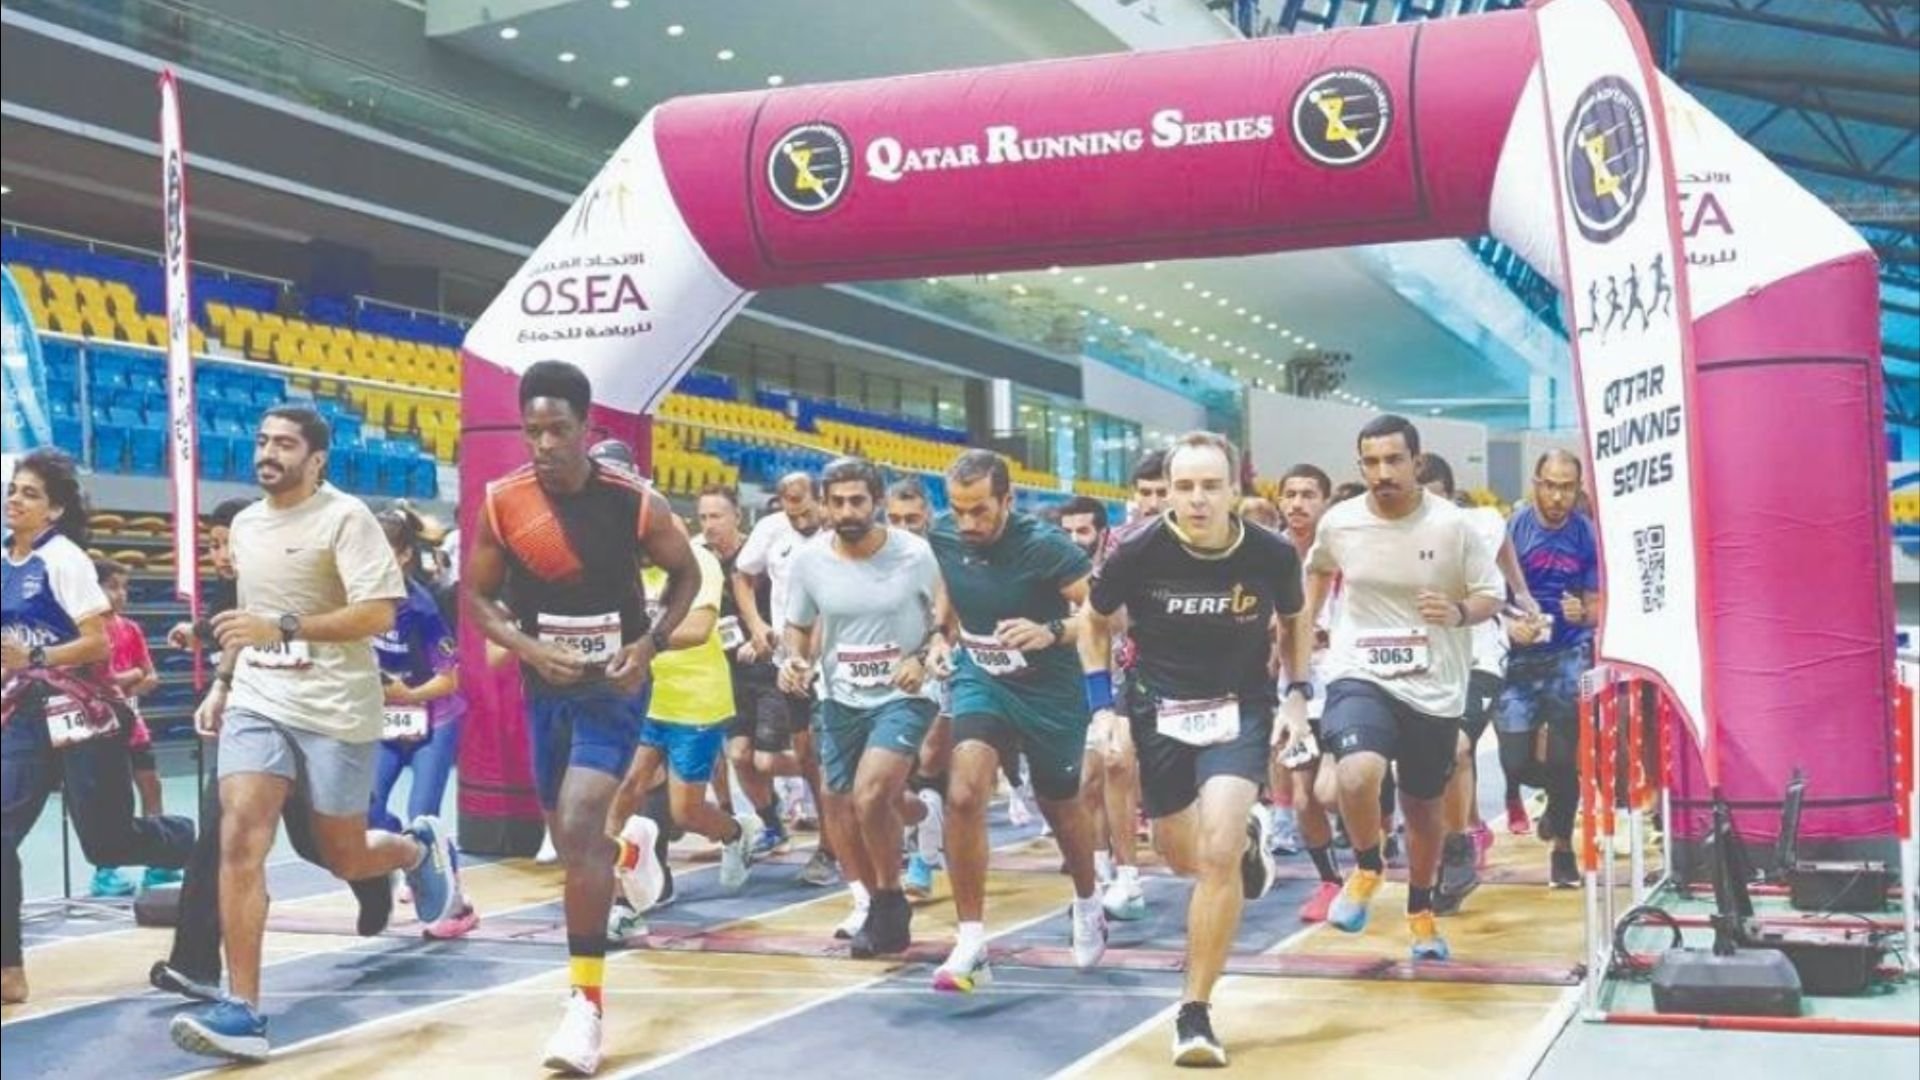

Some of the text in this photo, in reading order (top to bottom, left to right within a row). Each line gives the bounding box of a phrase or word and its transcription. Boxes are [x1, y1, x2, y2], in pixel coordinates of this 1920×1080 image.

[866, 109, 1274, 182] QATAR RUNNING SERIES
[1367, 647, 1415, 665] 3063
